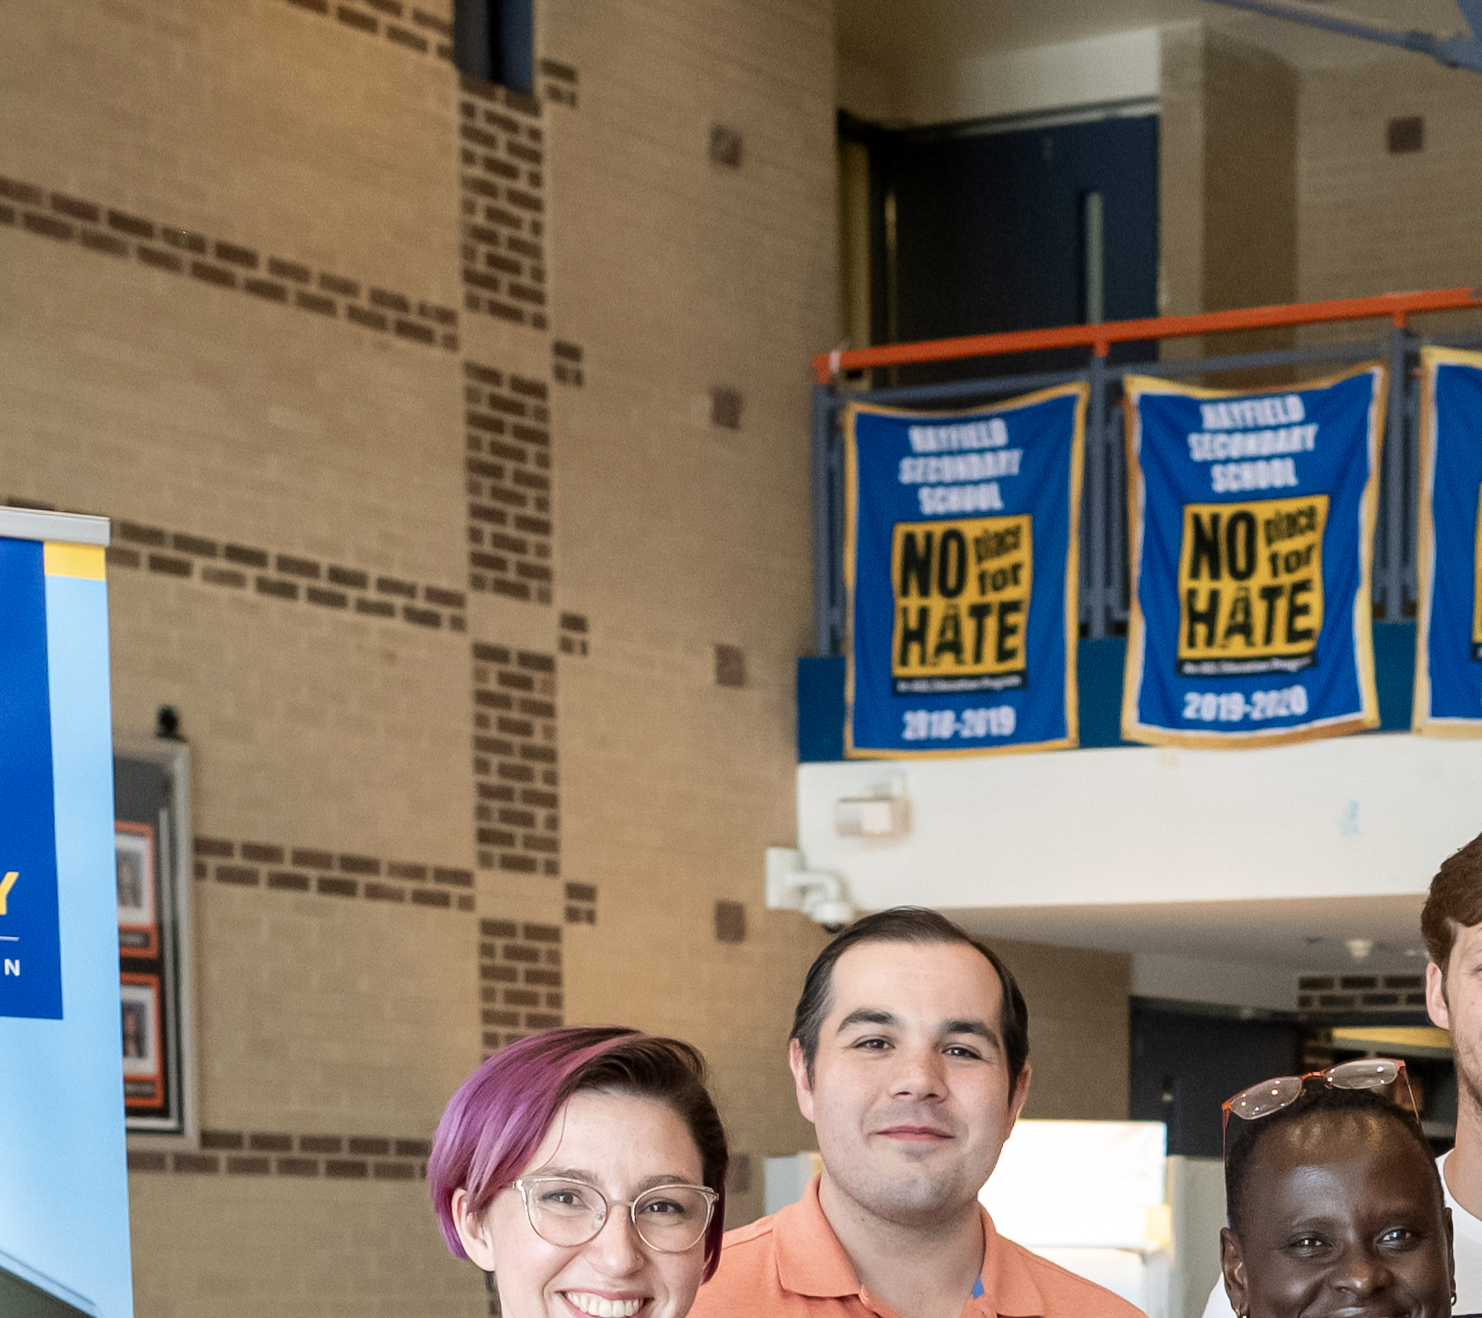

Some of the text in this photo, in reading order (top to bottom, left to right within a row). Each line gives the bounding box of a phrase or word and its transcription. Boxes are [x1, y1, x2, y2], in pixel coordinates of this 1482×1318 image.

[1200, 394, 1305, 430] HAYFIELD
[1187, 423, 1318, 462] SECONDARY
[898, 448, 1023, 485] SECONDARY
[1210, 457, 1298, 493] SCHOOL
[918, 482, 1004, 515] SCHOOL
[900, 529, 968, 599] NO
[1190, 511, 1258, 581] NO
[1269, 543, 1316, 578] for
[978, 563, 1023, 595] for
[1187, 579, 1313, 648] HATE
[900, 601, 1022, 667] HATE
[1183, 685, 1308, 721] 2019-2020
[901, 705, 1017, 740] 2018-2019
